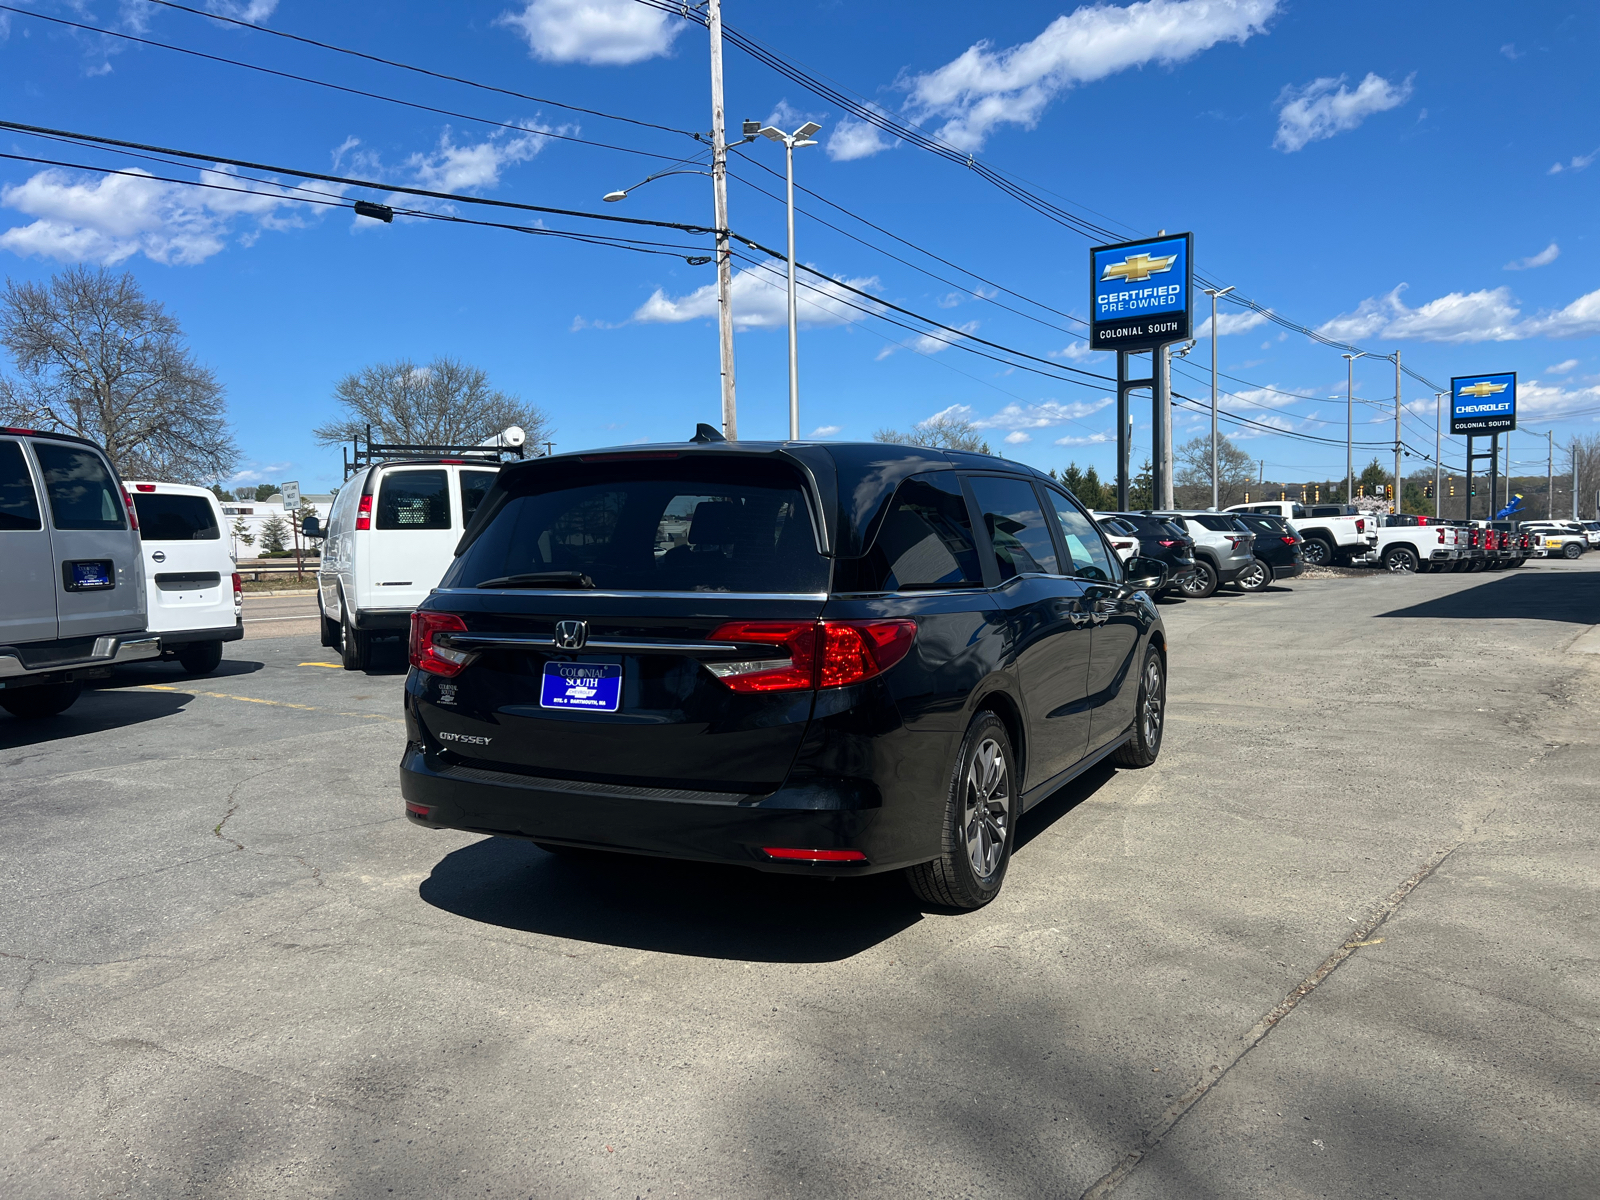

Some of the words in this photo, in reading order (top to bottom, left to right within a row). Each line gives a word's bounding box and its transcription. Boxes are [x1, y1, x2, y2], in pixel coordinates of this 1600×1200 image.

[1098, 284, 1180, 304] CERTIFIED
[1101, 295, 1176, 313] PRE-OWNED
[1100, 326, 1143, 339] COLONIAL
[1148, 322, 1178, 333] SOUTH
[1456, 402, 1510, 413] CHEVROLET
[560, 667, 606, 678] COLONIAL
[566, 677, 598, 687] SOUTH
[439, 731, 493, 746] ODYSSEY
